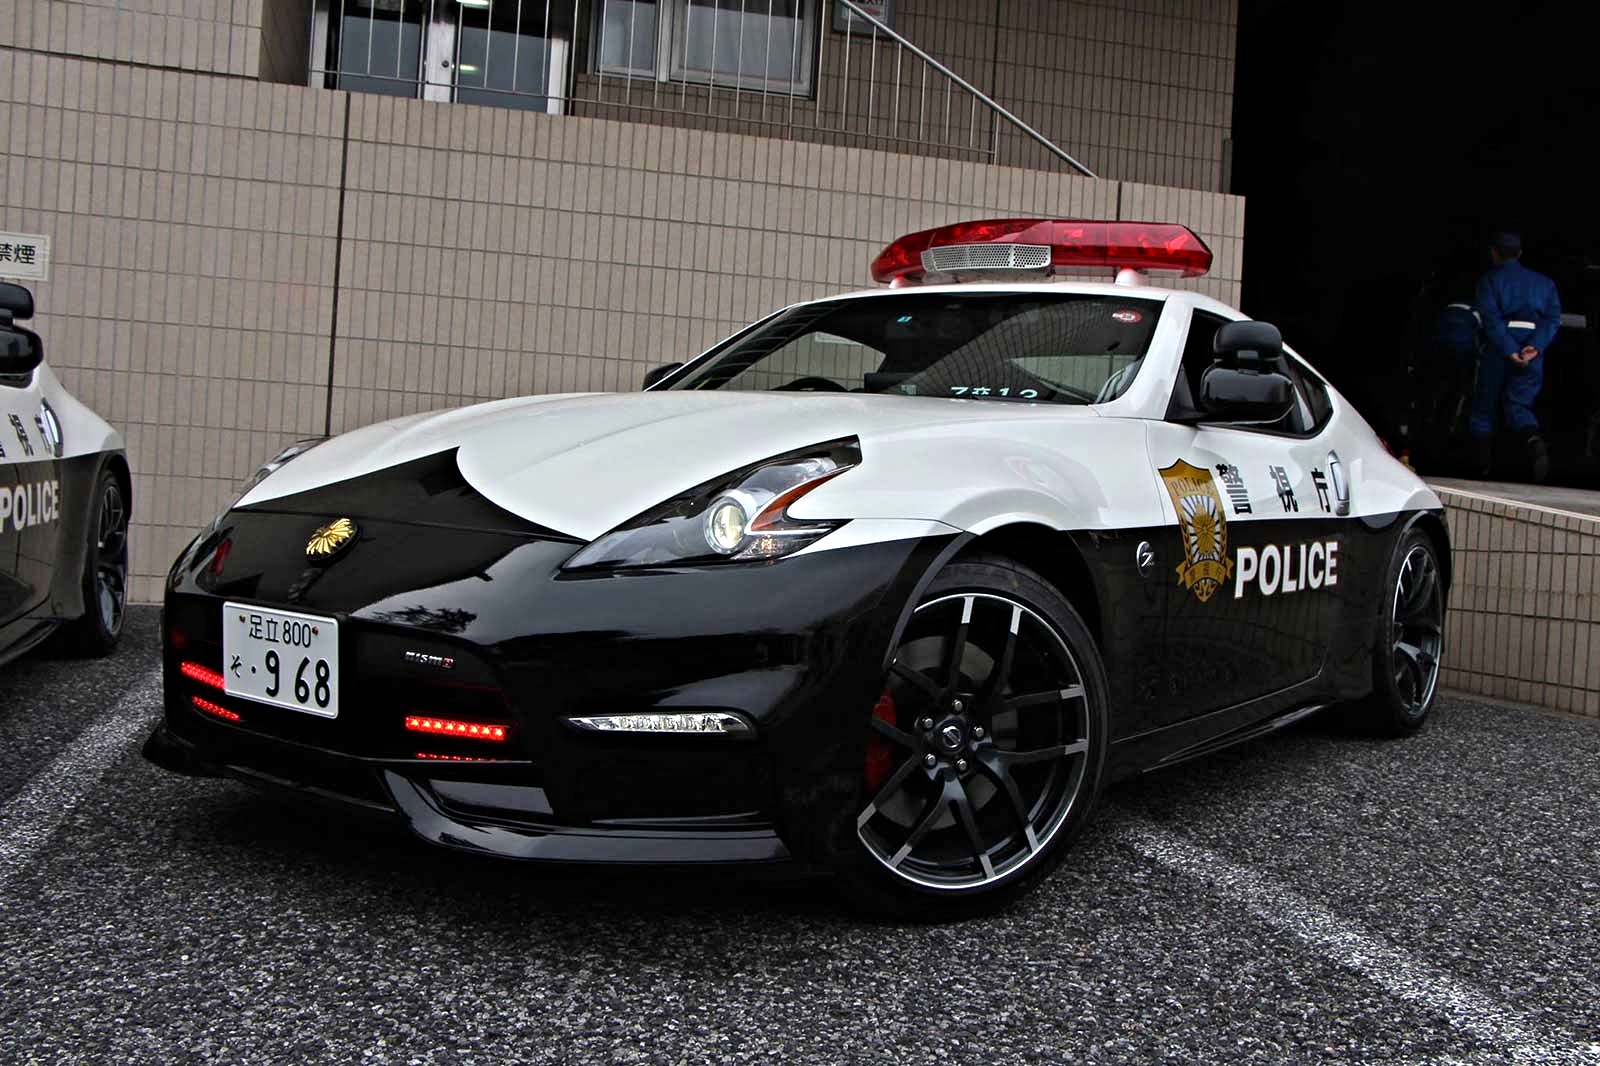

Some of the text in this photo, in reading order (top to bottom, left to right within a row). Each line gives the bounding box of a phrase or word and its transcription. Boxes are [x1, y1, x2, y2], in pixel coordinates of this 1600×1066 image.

[0, 480, 59, 534] POLICE
[1215, 463, 1331, 515] 警視庁
[1234, 541, 1338, 600] POLICE
